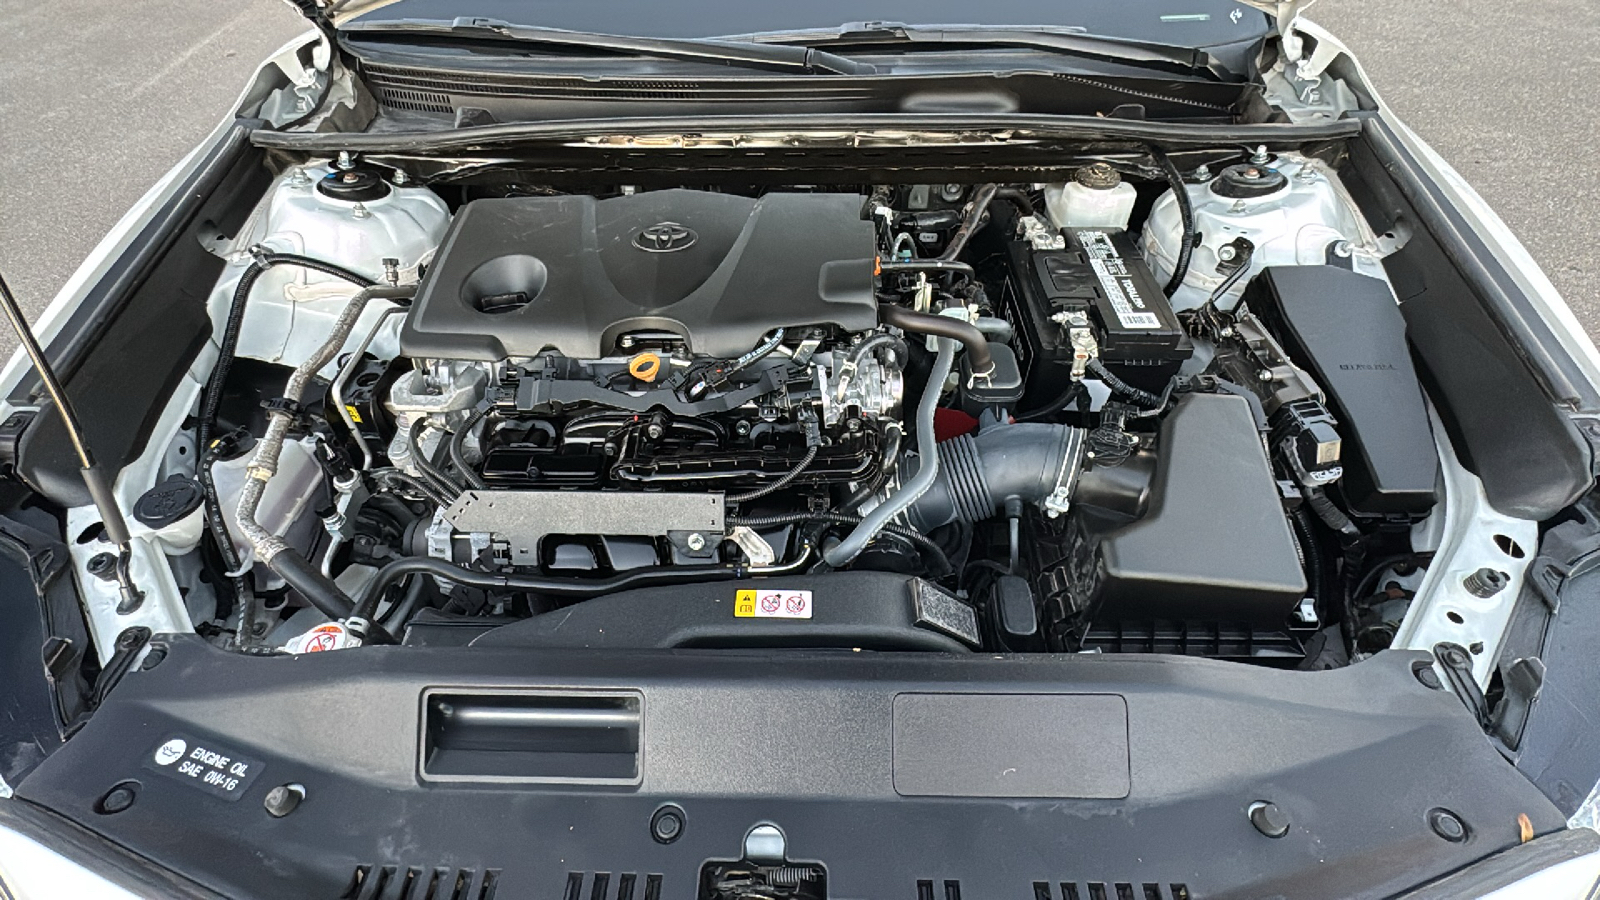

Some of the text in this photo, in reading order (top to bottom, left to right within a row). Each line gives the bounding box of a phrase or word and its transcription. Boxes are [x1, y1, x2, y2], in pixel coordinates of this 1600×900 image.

[178, 761, 239, 791] SAE 0W-16
[190, 747, 248, 777] ENGINE OIL
